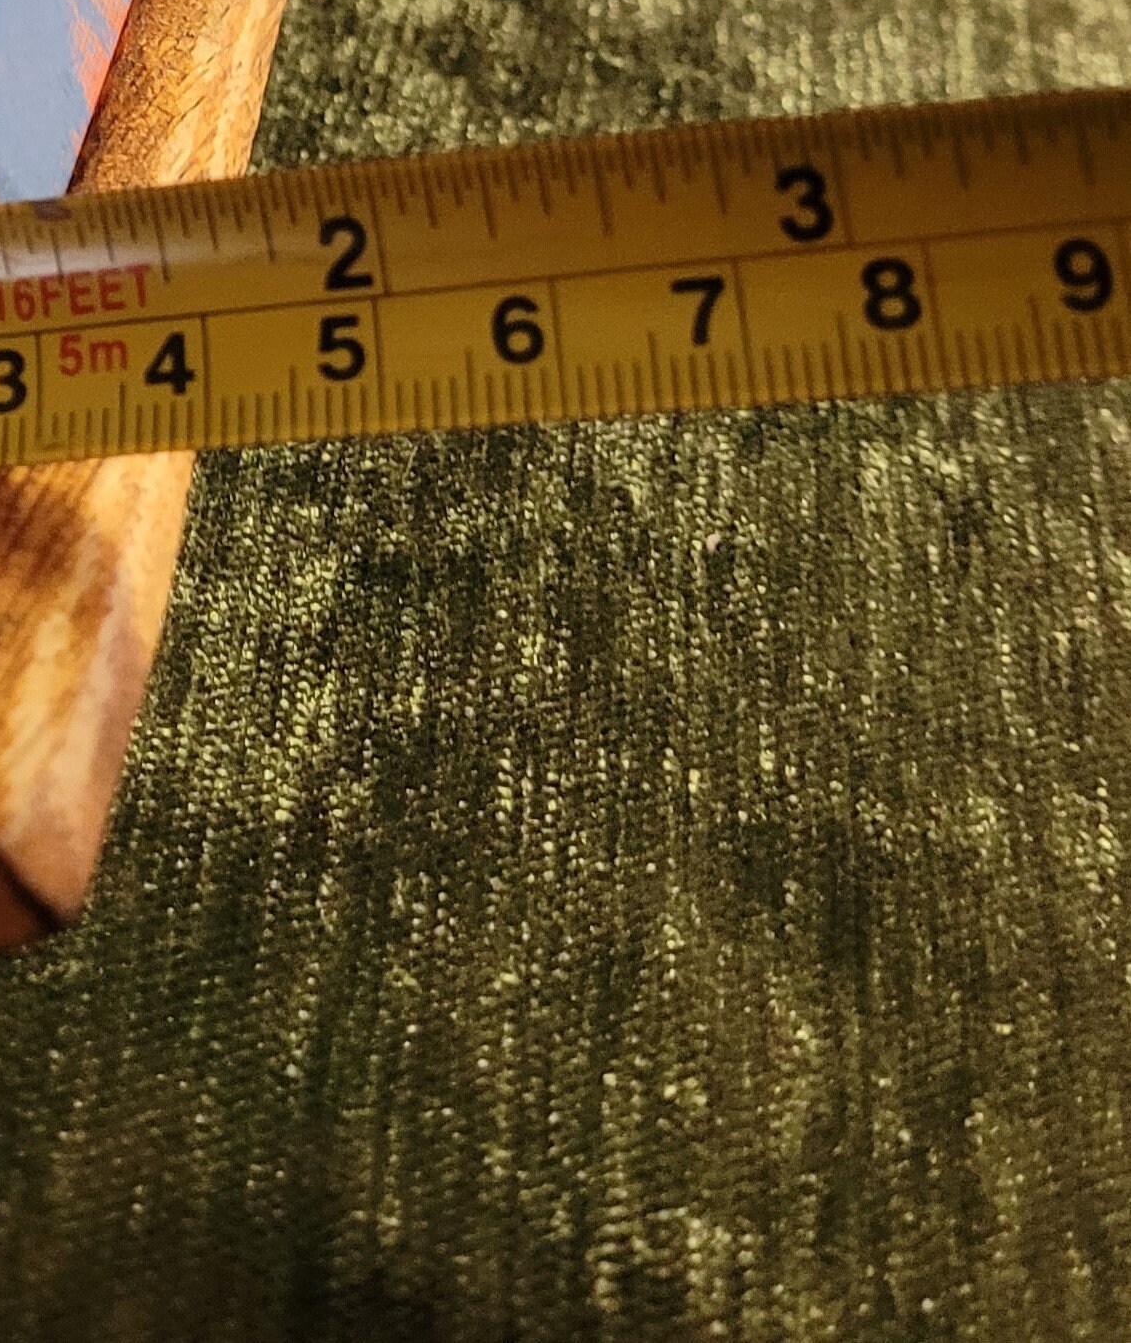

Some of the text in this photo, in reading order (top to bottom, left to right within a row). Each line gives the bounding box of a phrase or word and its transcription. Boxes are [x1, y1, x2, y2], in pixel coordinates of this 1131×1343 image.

[318, 216, 374, 291] 2
[774, 166, 834, 242] 3
[58, 334, 128, 377] 5m
[145, 332, 196, 395] 4
[317, 314, 366, 381] 5
[490, 296, 545, 364] 6
[672, 276, 725, 346] 7
[860, 257, 923, 332] 8
[1053, 238, 1114, 313] 9
